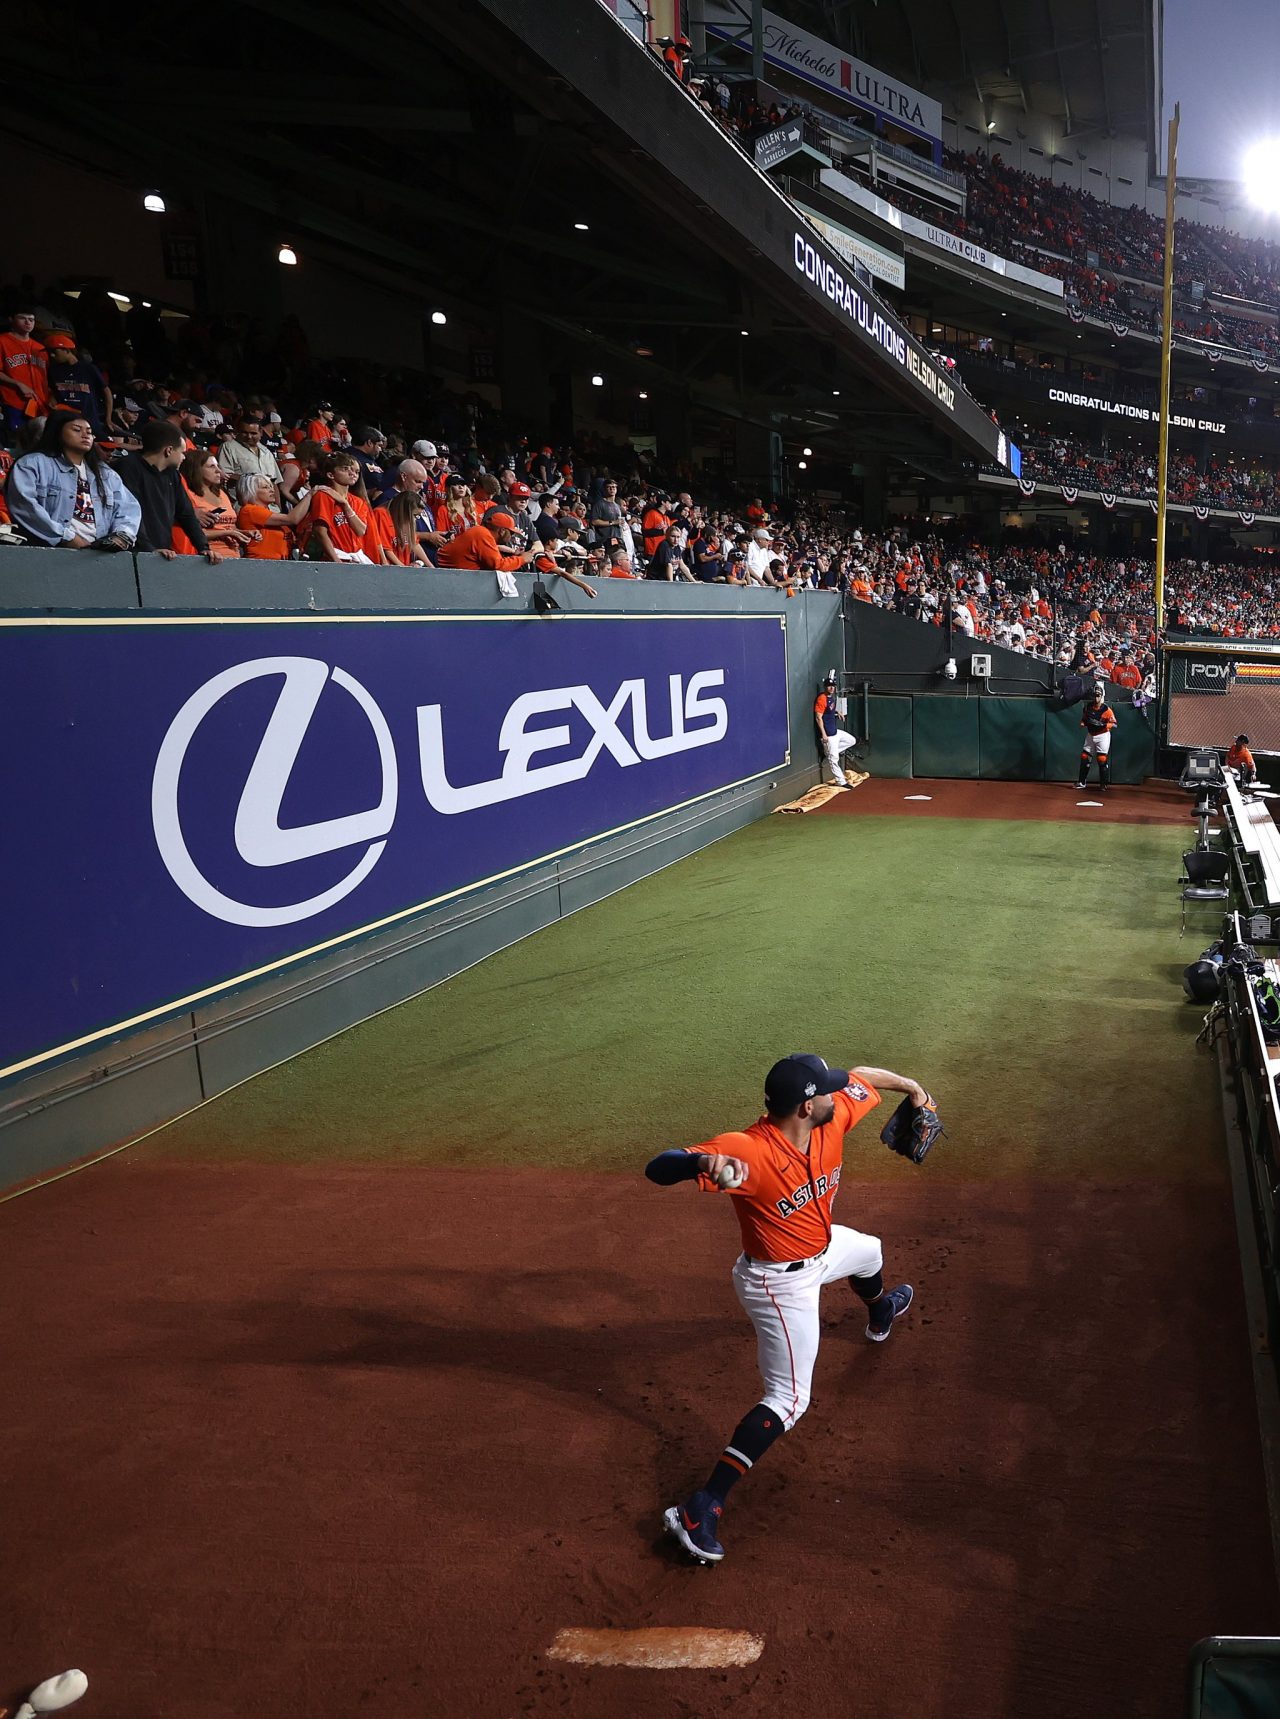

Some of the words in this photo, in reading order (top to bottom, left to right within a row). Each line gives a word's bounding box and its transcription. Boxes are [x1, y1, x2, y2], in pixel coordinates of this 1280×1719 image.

[762, 25, 836, 78] Michelob
[854, 70, 925, 128] ULTRA
[756, 131, 787, 154] KILLEN'S
[927, 227, 958, 253] ULTRA
[964, 246, 986, 263] CLUB
[794, 233, 905, 366] CONGRATULATIONS
[906, 345, 937, 395] NELSON
[937, 377, 955, 411] CRUZ
[1049, 388, 1150, 420] CONGRATULATIONS
[1151, 411, 1196, 429] NLSON
[1198, 419, 1226, 434] CRUZ
[417, 669, 729, 815] LEXUS
